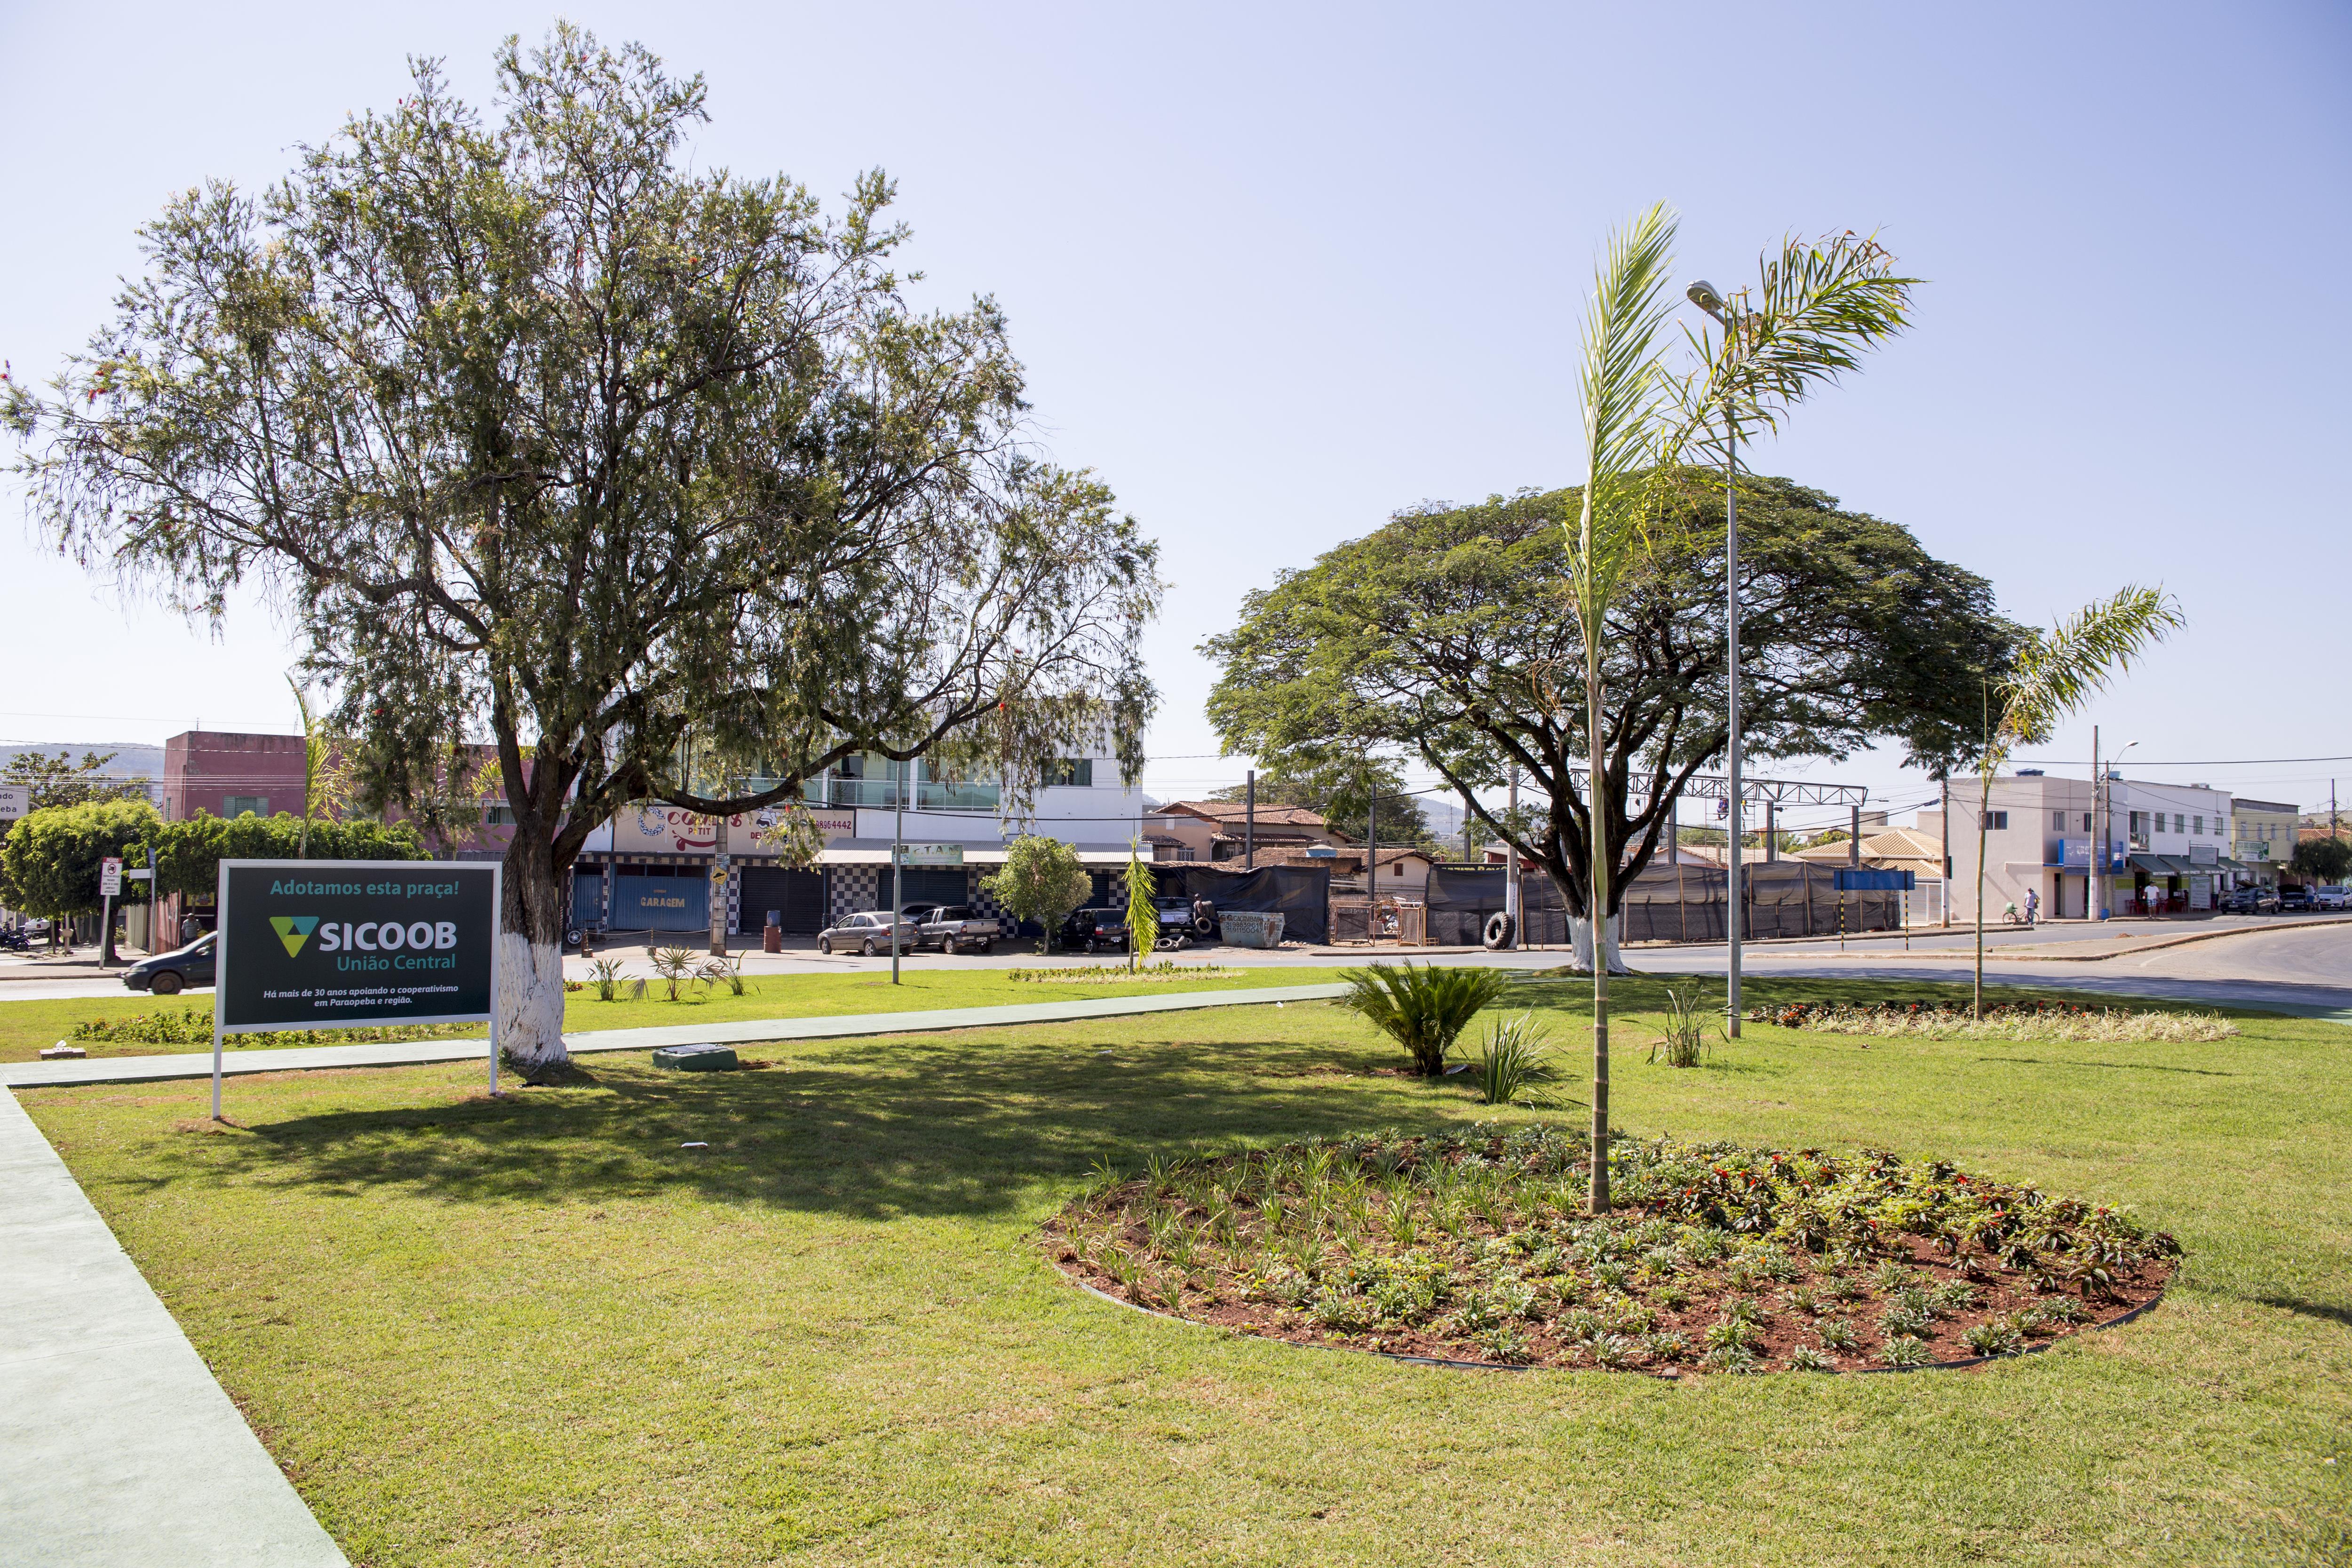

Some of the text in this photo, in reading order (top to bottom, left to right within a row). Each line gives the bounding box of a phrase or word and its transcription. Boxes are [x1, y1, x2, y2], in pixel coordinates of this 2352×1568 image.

[270, 879, 459, 899] Adotamos esta praça!
[641, 897, 685, 907] GARAGEM
[318, 922, 457, 951] SICOOB
[337, 953, 455, 971] União Central
[263, 990, 277, 998] Há
[278, 989, 300, 998] mais
[349, 986, 388, 997] apoiando
[397, 985, 459, 995] cooperativismo
[330, 997, 375, 1007] Paraopeba
[384, 996, 413, 1006] região.
